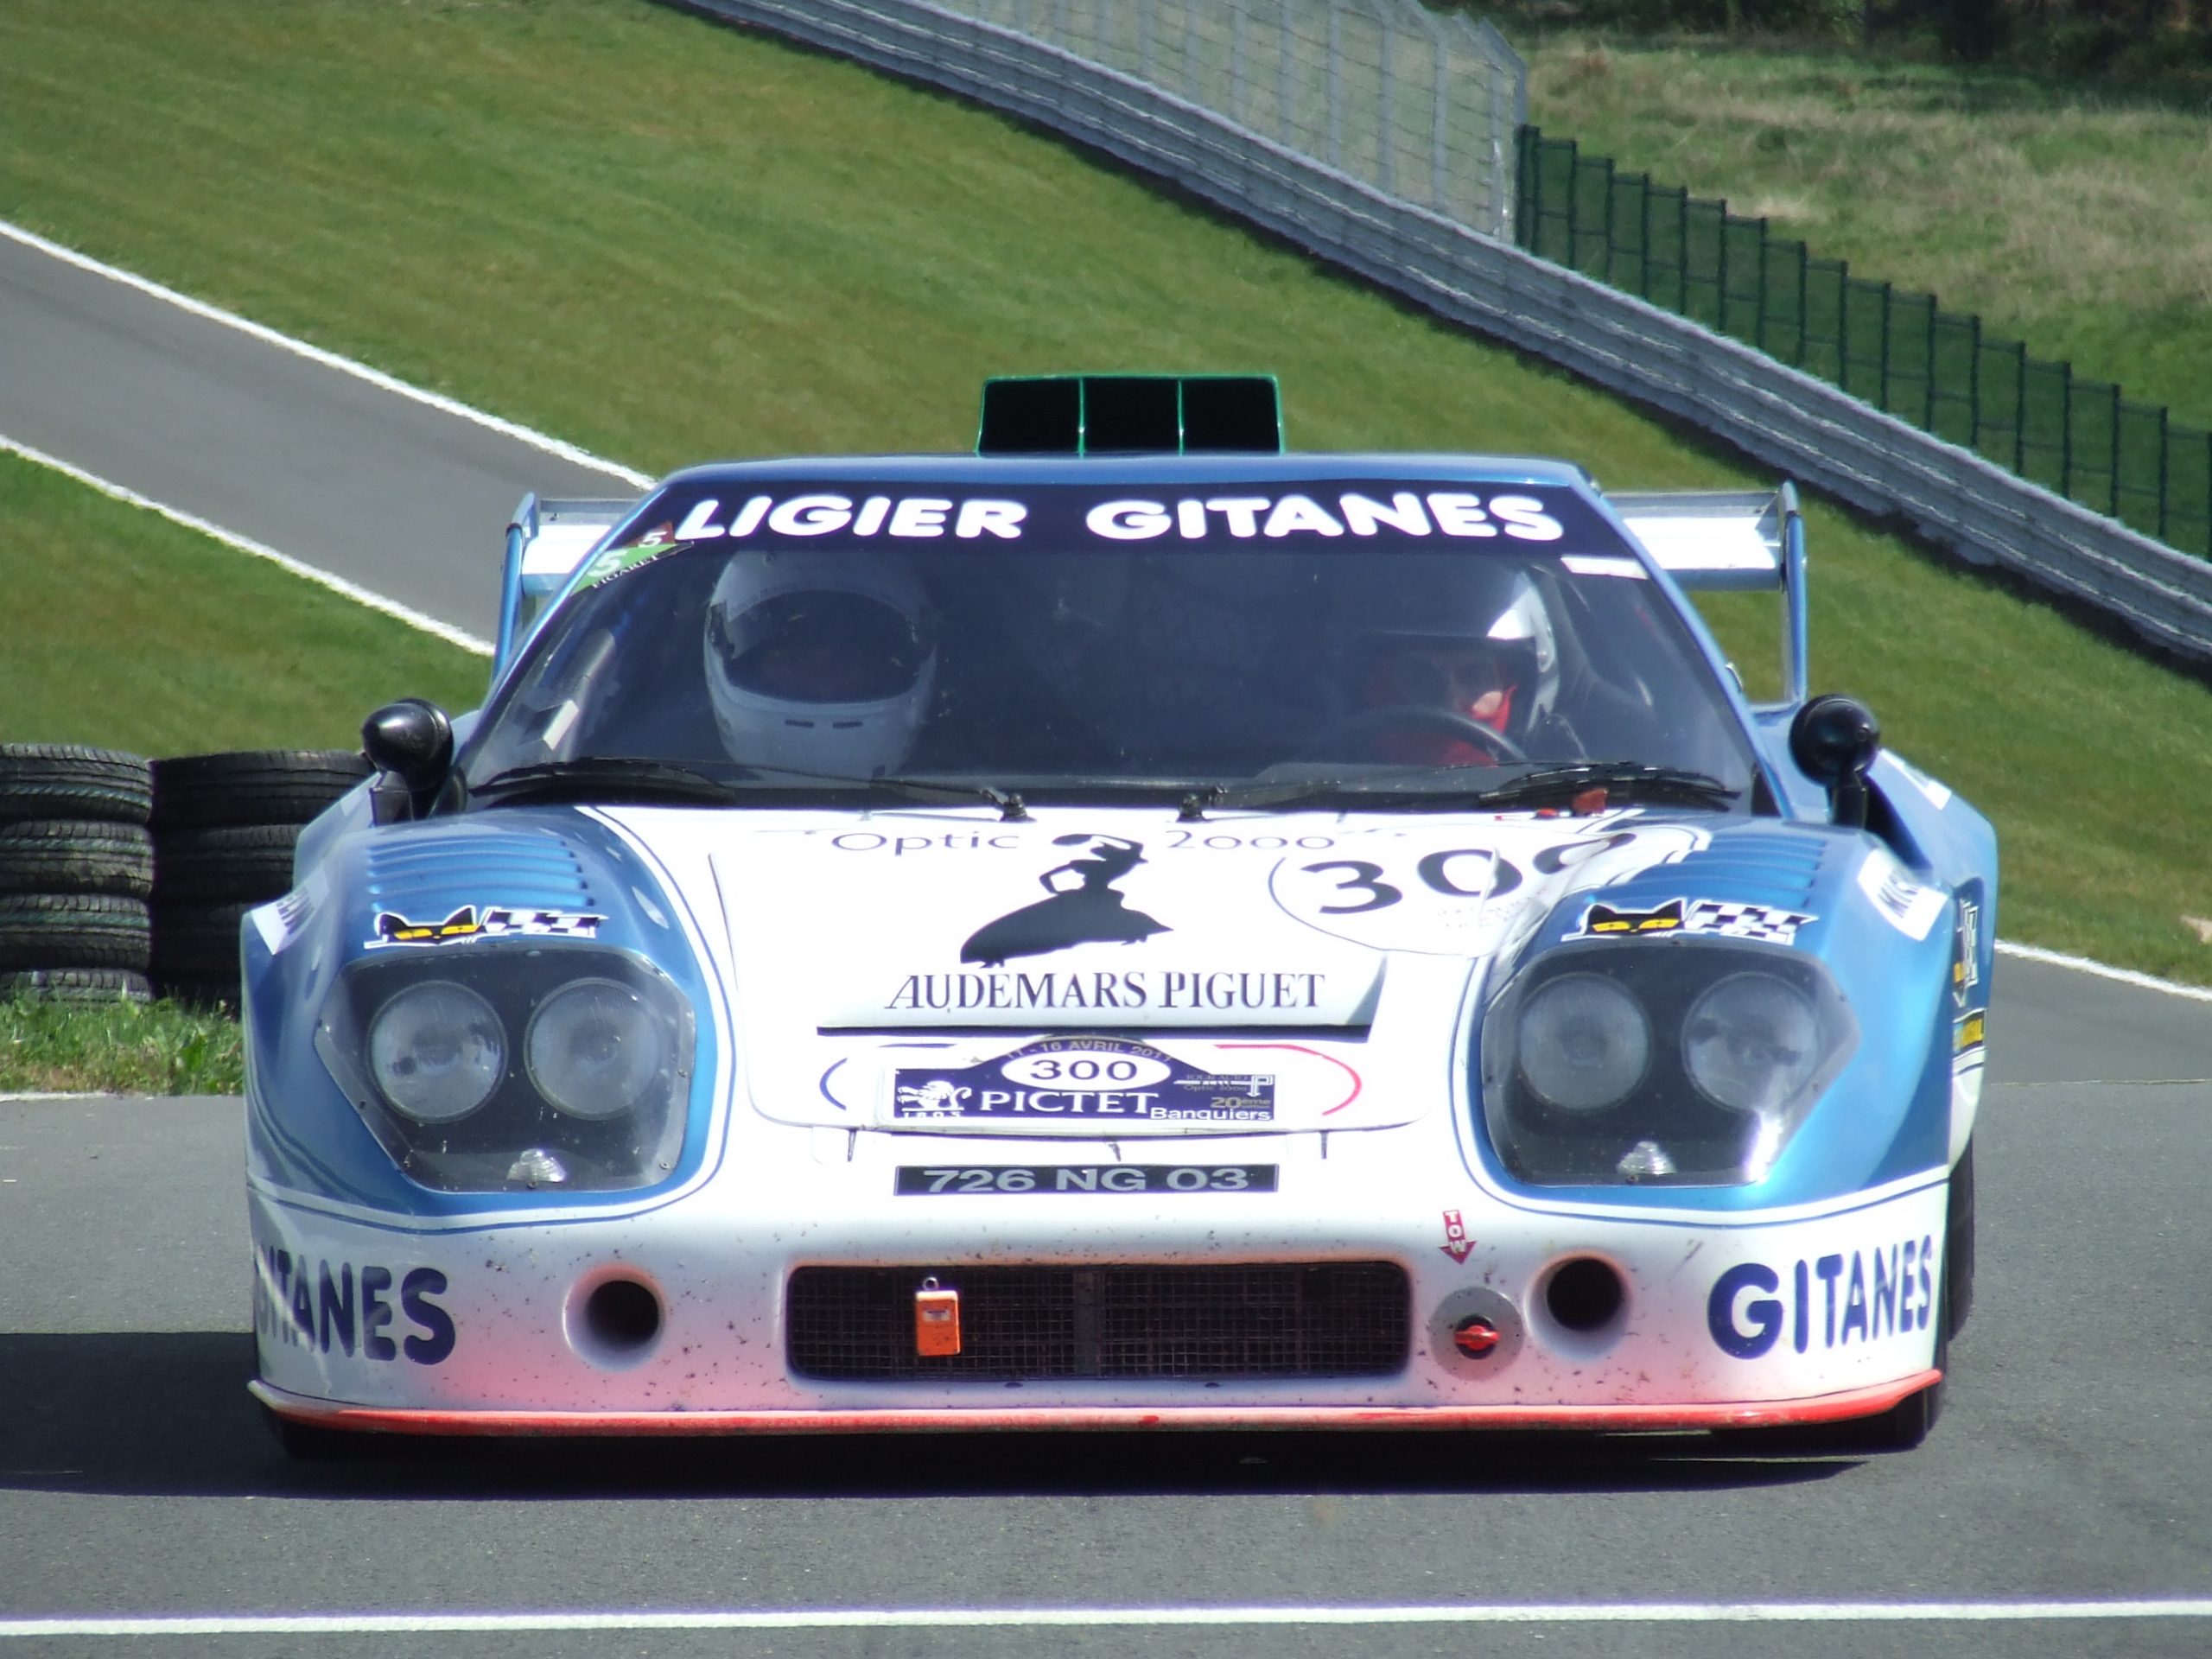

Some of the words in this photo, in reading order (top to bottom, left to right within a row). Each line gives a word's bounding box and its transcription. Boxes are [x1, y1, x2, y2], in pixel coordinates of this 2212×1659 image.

[675, 495, 1028, 540] LIGIER
[1086, 492, 1564, 541] GITANES
[830, 830, 1020, 856] Optic
[1165, 829, 1337, 851] 2000
[884, 972, 1147, 1009] AUDEMARS
[1158, 970, 1325, 1009] PIGUET
[1068, 1040, 1123, 1052] AVRIL
[1029, 1059, 1138, 1081] 300
[980, 1090, 1159, 1114] PICTET
[1150, 1107, 1272, 1121] Banquiers
[923, 1169, 1036, 1192] 726
[1056, 1167, 1147, 1192] NG
[1166, 1167, 1249, 1191] 03
[255, 1246, 456, 1366] ITANES
[1707, 1235, 1932, 1360] GITANES
